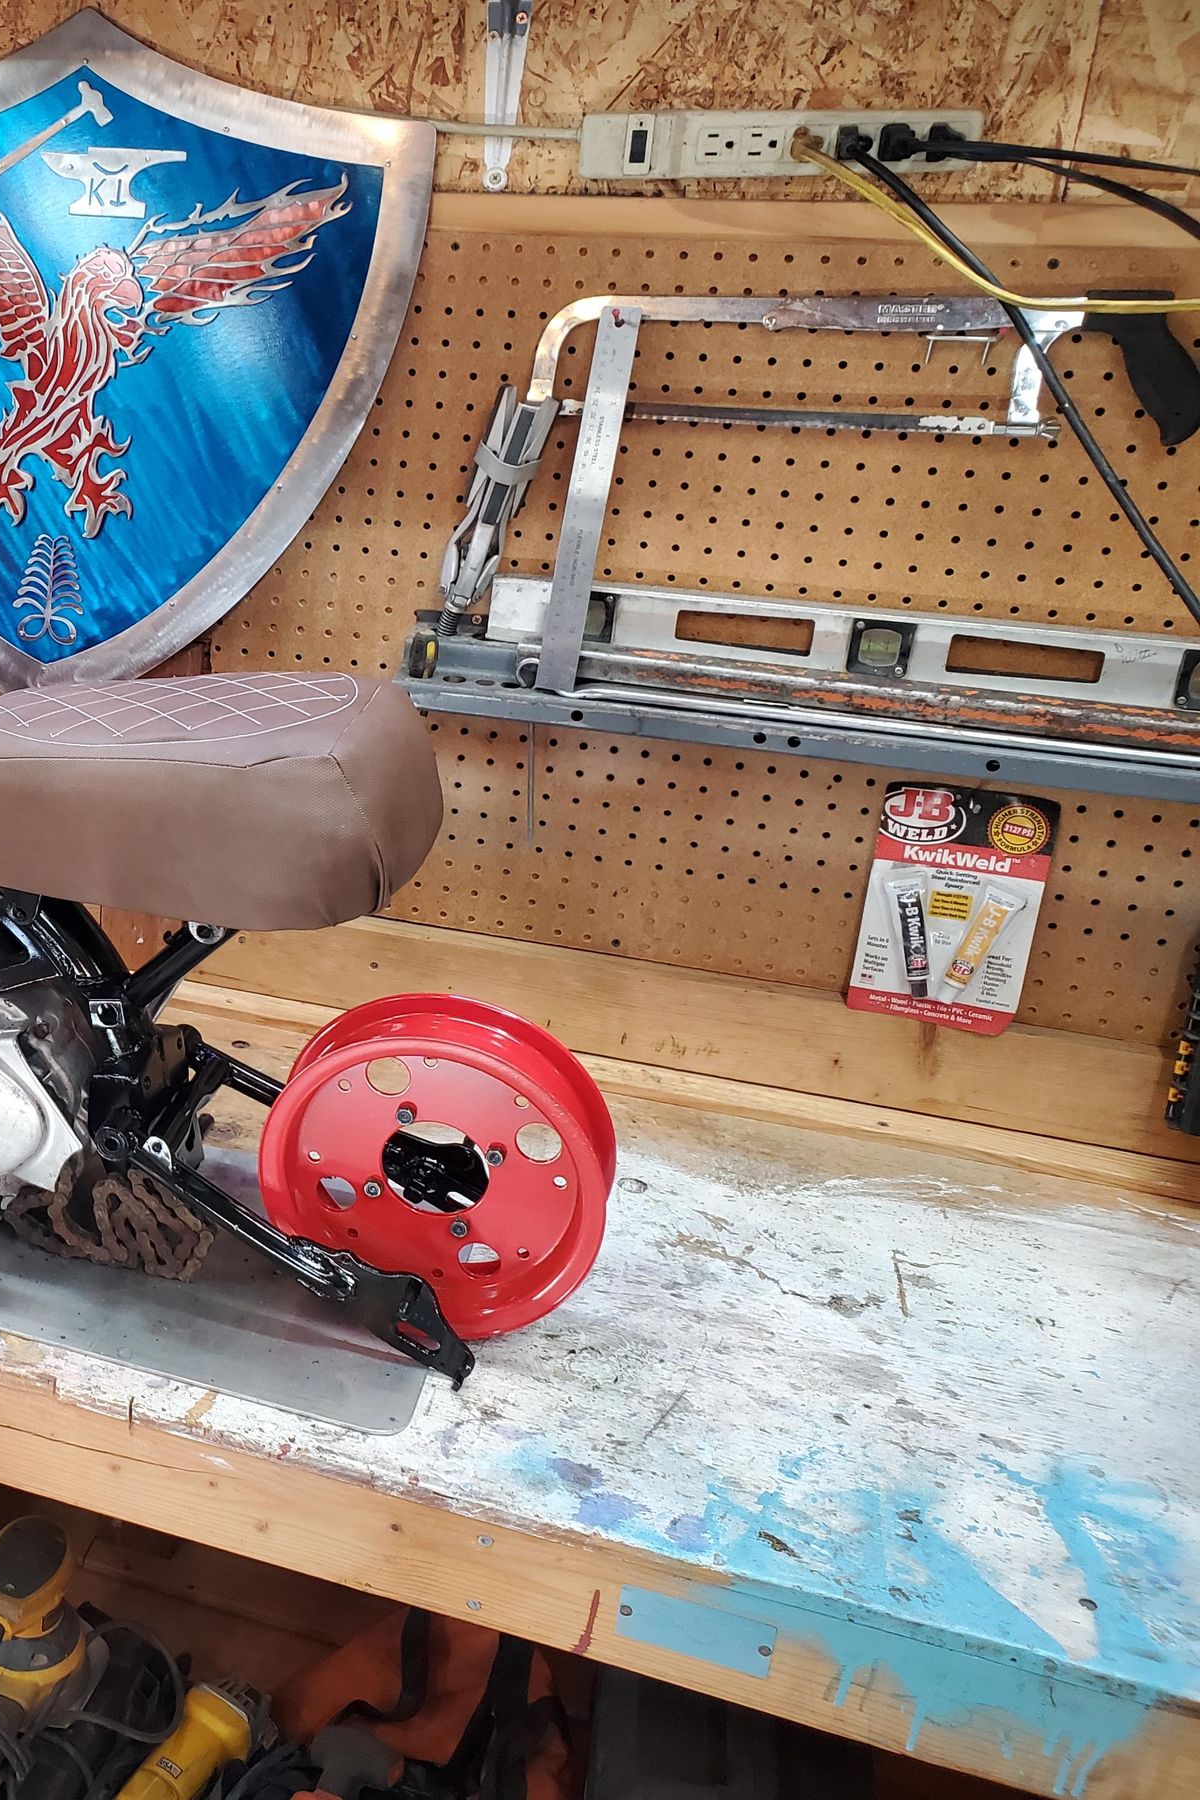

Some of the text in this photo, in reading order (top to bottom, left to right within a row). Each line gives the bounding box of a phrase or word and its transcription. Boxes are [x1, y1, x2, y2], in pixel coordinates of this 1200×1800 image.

[596, 416, 605, 448] STAINLESS
[888, 818, 948, 841] WELD
[993, 809, 1044, 841] HIGHER STRENGTH
[1003, 823, 1035, 839] 3127 PSI
[997, 838, 1032, 852] FORMULA
[904, 844, 1012, 873] KwikWeld
[944, 882, 965, 890] Epoxy
[869, 994, 887, 1002] Metal
[891, 997, 908, 1005] Wood
[912, 1001, 932, 1010] Plastic
[951, 1007, 964, 1016] PVC
[968, 1010, 993, 1021] Ceramic
[889, 1004, 919, 1014] Fiberglass
[923, 1010, 950, 1020] Concrete
[956, 1015, 973, 1025] More
[159, 1759, 173, 1771] USA
